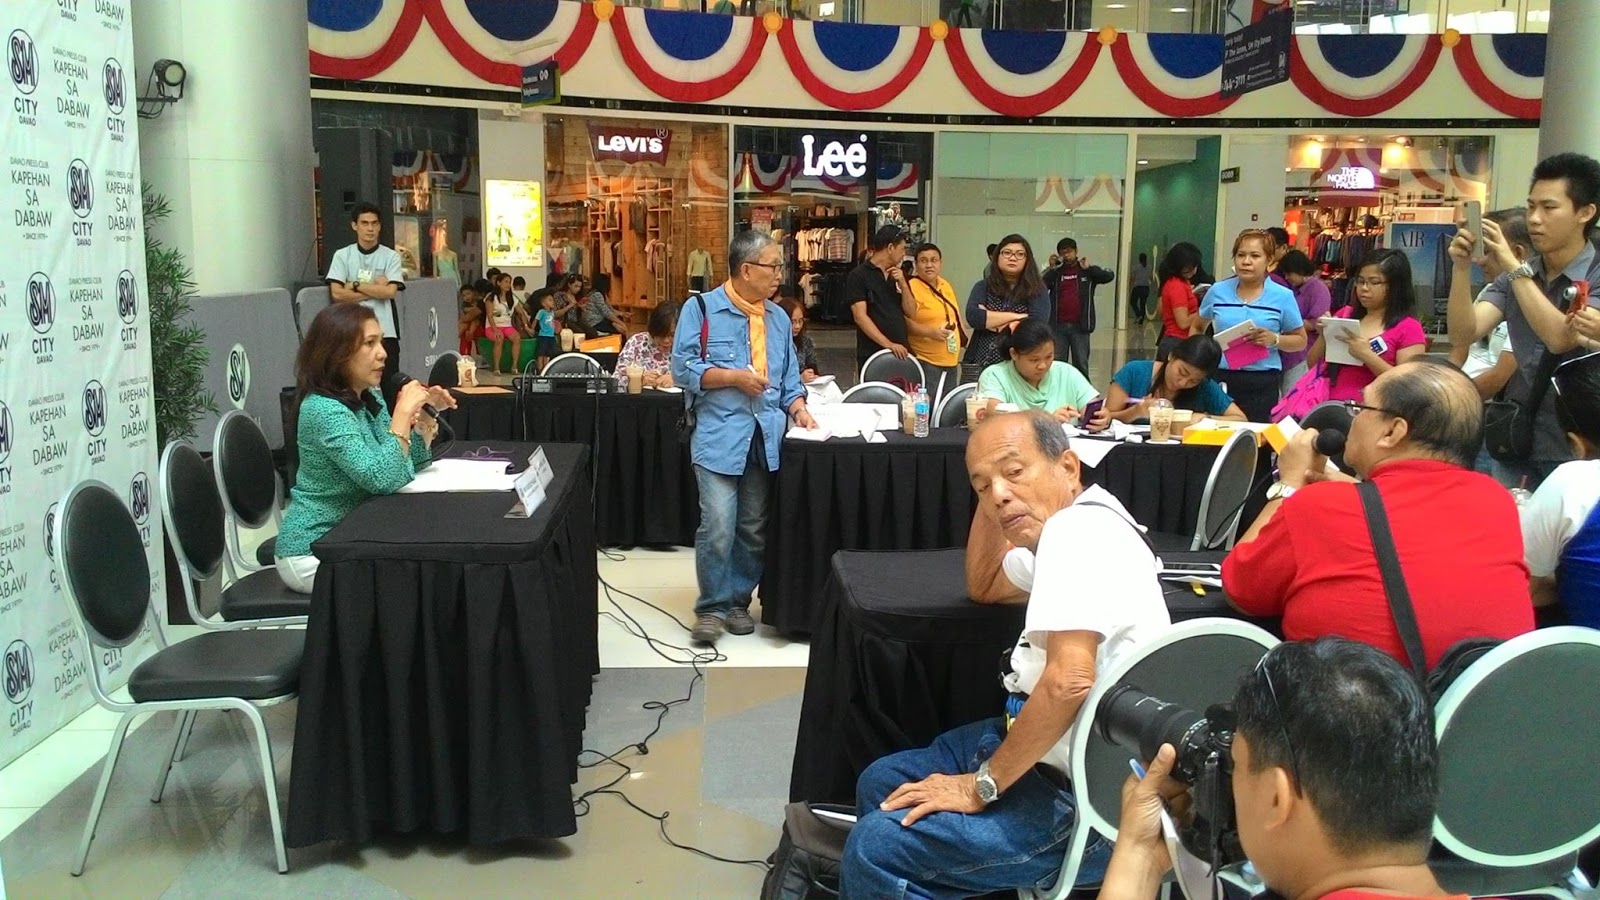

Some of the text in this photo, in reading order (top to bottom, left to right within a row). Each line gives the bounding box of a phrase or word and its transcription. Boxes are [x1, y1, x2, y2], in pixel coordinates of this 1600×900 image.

[95, 0, 124, 21] DABAW
[11, 36, 35, 86] SM
[53, 59, 88, 80] KAPEHAN
[66, 78, 79, 98] SA
[105, 64, 124, 108] SM
[14, 96, 38, 116] CITY
[56, 96, 90, 118] DABAW
[19, 116, 36, 126] DAVAO
[106, 116, 126, 133] CITY
[110, 133, 124, 142] DAVAO
[802, 134, 867, 178] Lee
[11, 170, 50, 188] KAPEHAN
[1326, 174, 1360, 183] NORTH
[1341, 166, 1359, 175] THE
[26, 188, 40, 206] SA
[70, 166, 90, 210] SM
[106, 180, 134, 196] KAPEHAN
[116, 196, 128, 212] SA
[15, 209, 52, 228] DABAW
[108, 214, 136, 231] DABAW
[72, 222, 94, 236] CITY
[76, 238, 92, 246] DAVAO
[1400, 230, 1425, 248] AIR
[30, 280, 53, 326] SM
[70, 288, 103, 303] KAPEHAN
[120, 277, 136, 318] SM
[82, 304, 94, 321] SA
[73, 322, 104, 342] DABAW
[121, 327, 138, 342] CITY
[32, 337, 54, 354] CITY
[124, 342, 136, 350] DAVAO
[36, 354, 53, 364] DAVAO
[120, 387, 150, 404] KAPEHAN
[30, 405, 66, 425] KAPEHAN
[86, 388, 104, 430] SM
[129, 404, 140, 419] SA
[42, 424, 56, 442] SA
[32, 441, 68, 466] DABAW
[88, 438, 107, 456] CITY
[0, 534, 25, 556] EHAN
[0, 558, 14, 578] SA
[0, 572, 27, 599] ABAW
[62, 648, 74, 666] SA
[104, 648, 122, 666] CITY
[6, 646, 31, 698] SM
[54, 661, 86, 692] DABAW
[10, 700, 33, 728] CITY
[12, 721, 32, 737] DAVAO
